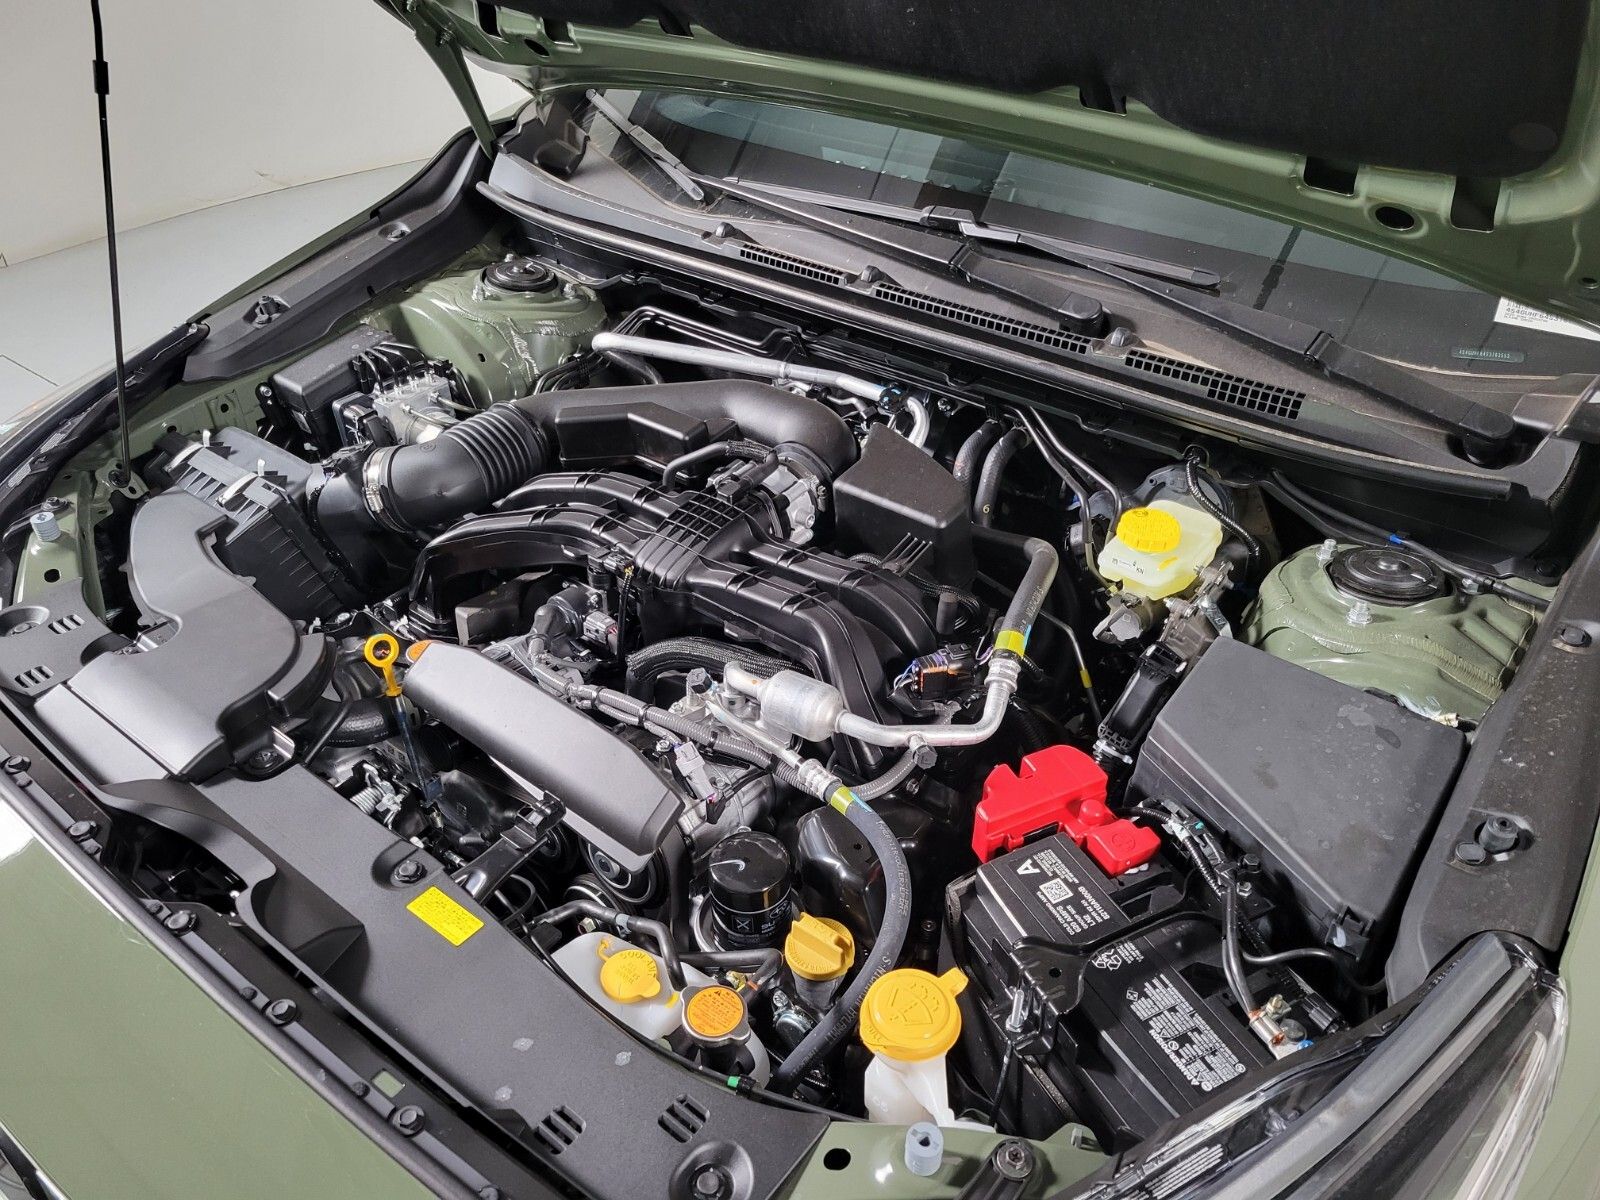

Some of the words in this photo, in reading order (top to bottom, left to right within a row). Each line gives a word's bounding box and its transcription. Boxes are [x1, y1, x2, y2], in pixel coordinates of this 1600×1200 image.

[982, 503, 991, 514] 6
[1016, 858, 1041, 875] A
[1055, 905, 1073, 922] AMPS
[1082, 914, 1096, 926] LN2
[1069, 921, 1082, 932] 620
[1148, 1028, 1194, 1080] DANGER/POISON
